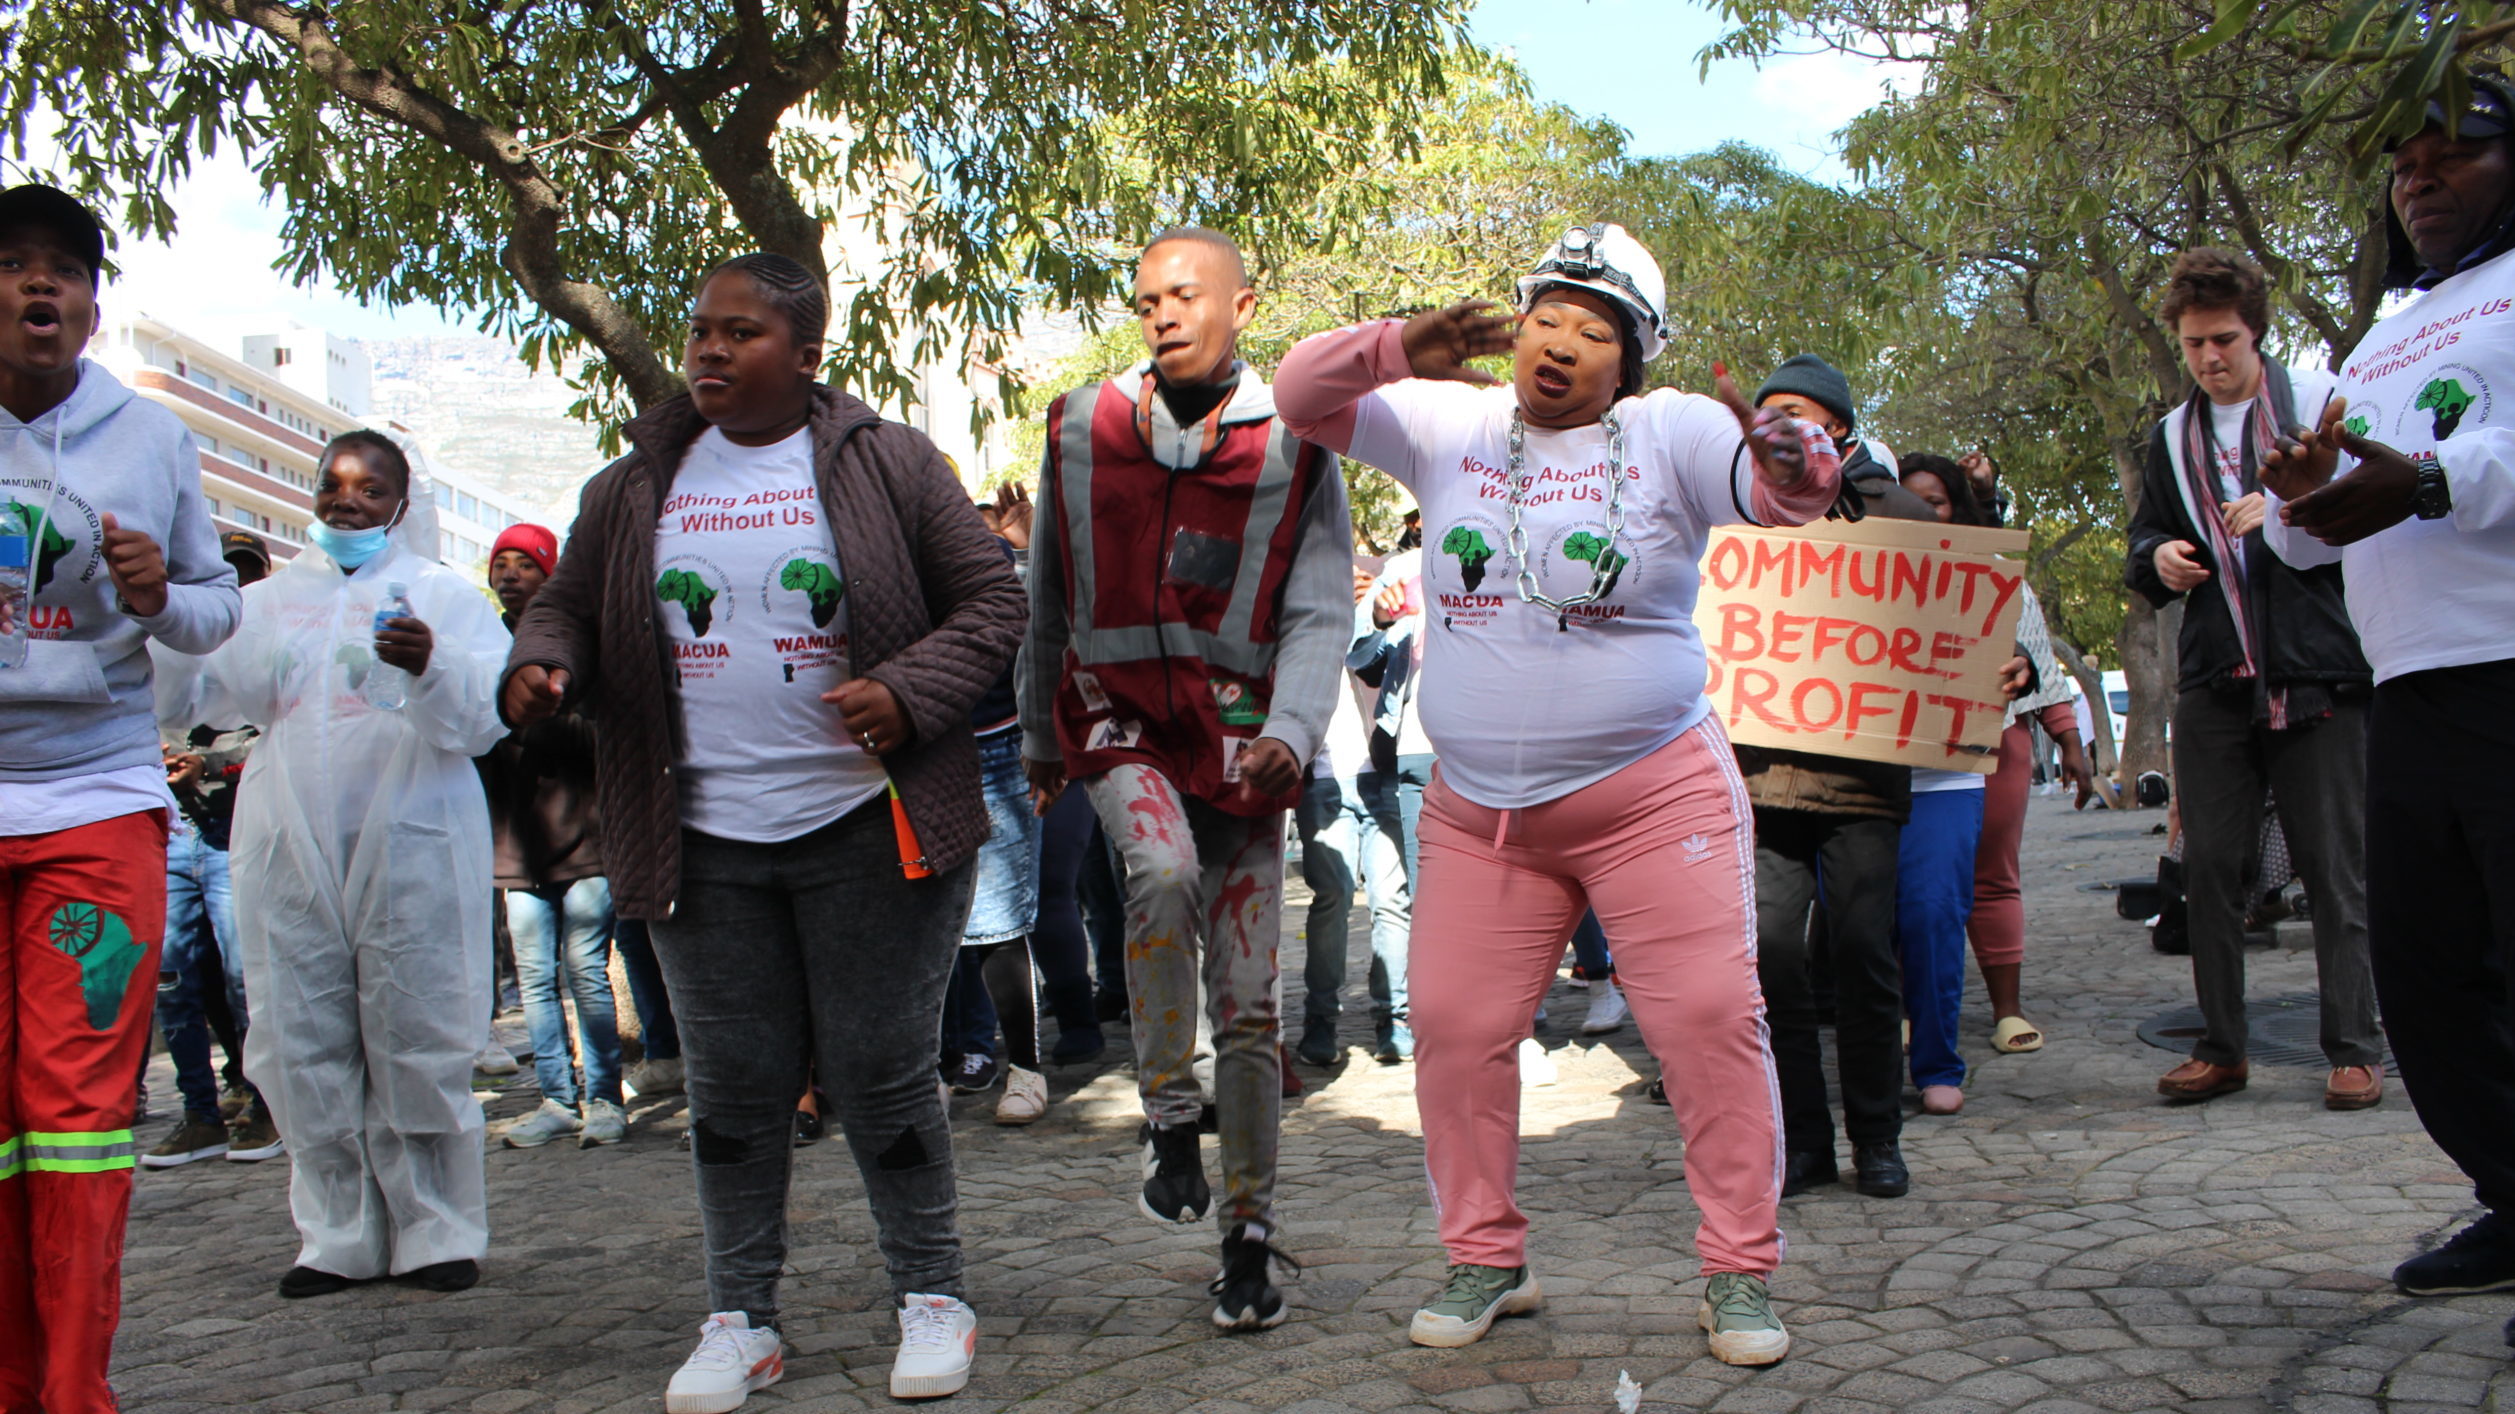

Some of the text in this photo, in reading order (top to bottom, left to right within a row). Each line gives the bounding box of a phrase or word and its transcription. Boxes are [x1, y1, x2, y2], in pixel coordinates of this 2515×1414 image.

[2346, 297, 2512, 381] Nothing About Us
[2361, 331, 2461, 384] Without Us
[2461, 364, 2484, 384] UNITED
[2481, 383, 2488, 392] IN
[1538, 461, 1606, 484] About
[663, 485, 815, 514] othing About
[1571, 484, 1603, 502] Us
[68, 492, 99, 528] UNITED
[681, 507, 816, 533] Without Us
[92, 531, 102, 541] IN
[79, 544, 101, 585] ACTION
[1439, 594, 1504, 608] MACUA
[1562, 604, 1625, 618] AMUA
[773, 633, 848, 653] WAMUA
[1707, 602, 1979, 681] BEFORE
[1683, 851, 1712, 862] adidas
